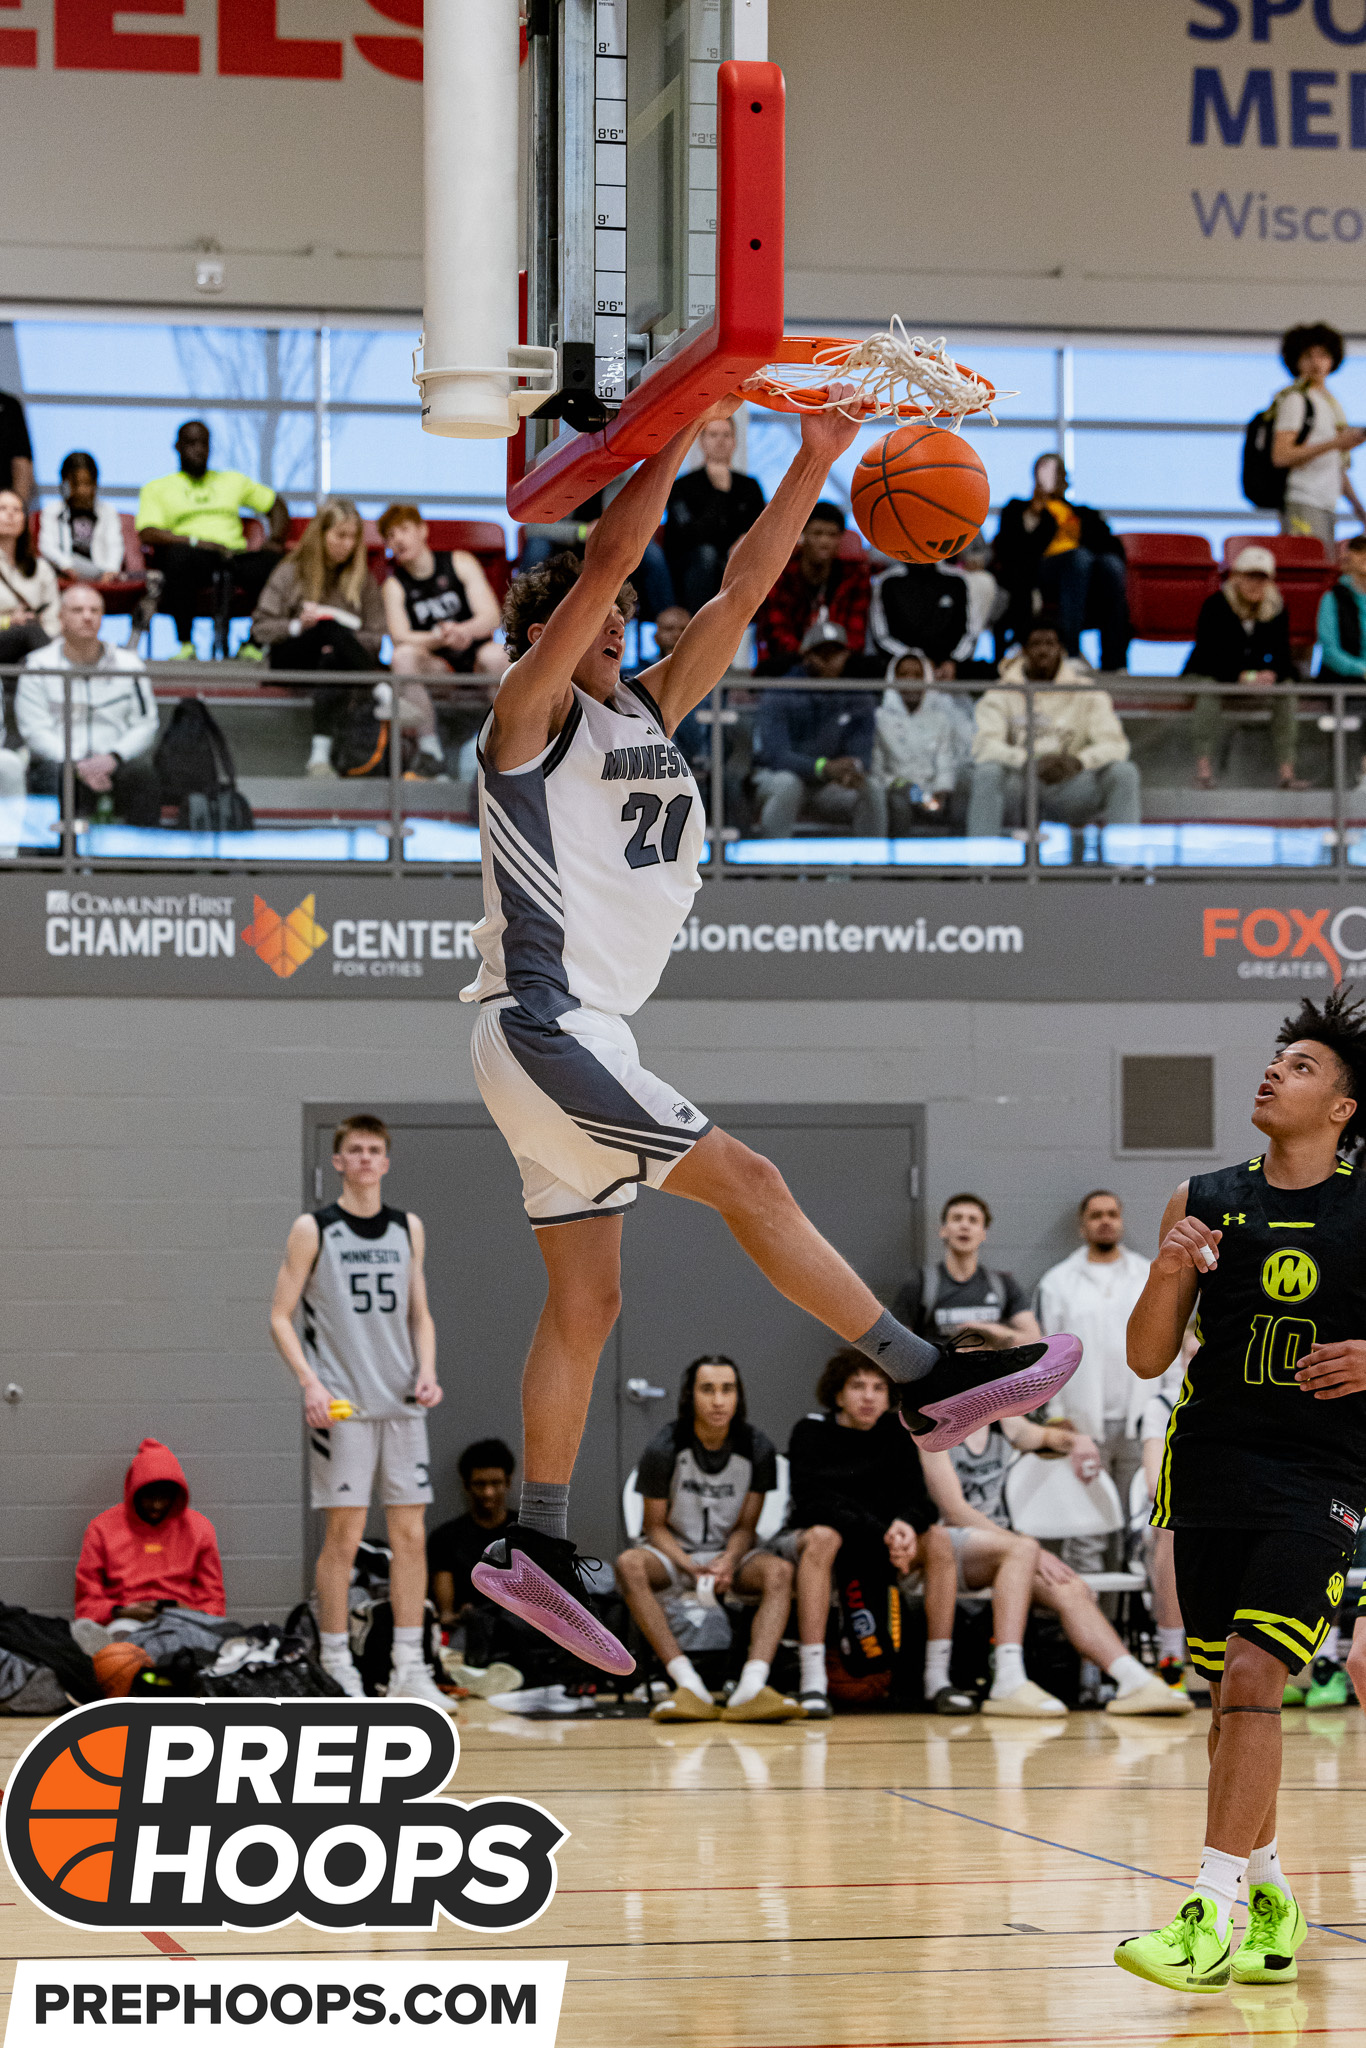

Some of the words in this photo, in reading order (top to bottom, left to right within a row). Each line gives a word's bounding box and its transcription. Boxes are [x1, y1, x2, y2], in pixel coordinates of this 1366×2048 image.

[598, 42, 610, 53] 8'
[597, 128, 624, 140] 8'6"
[597, 214, 610, 226] 9'
[1190, 190, 1364, 243] Wisco
[597, 300, 623, 312] 9'6"
[620, 792, 693, 870] 21
[46, 917, 236, 957] CHAMPION
[332, 919, 478, 959] CENTER
[332, 960, 366, 977] FOX
[369, 960, 424, 977] CITIES
[1237, 961, 1328, 979] GREATER
[350, 1272, 397, 1314] 55
[1244, 1314, 1317, 1386] 10
